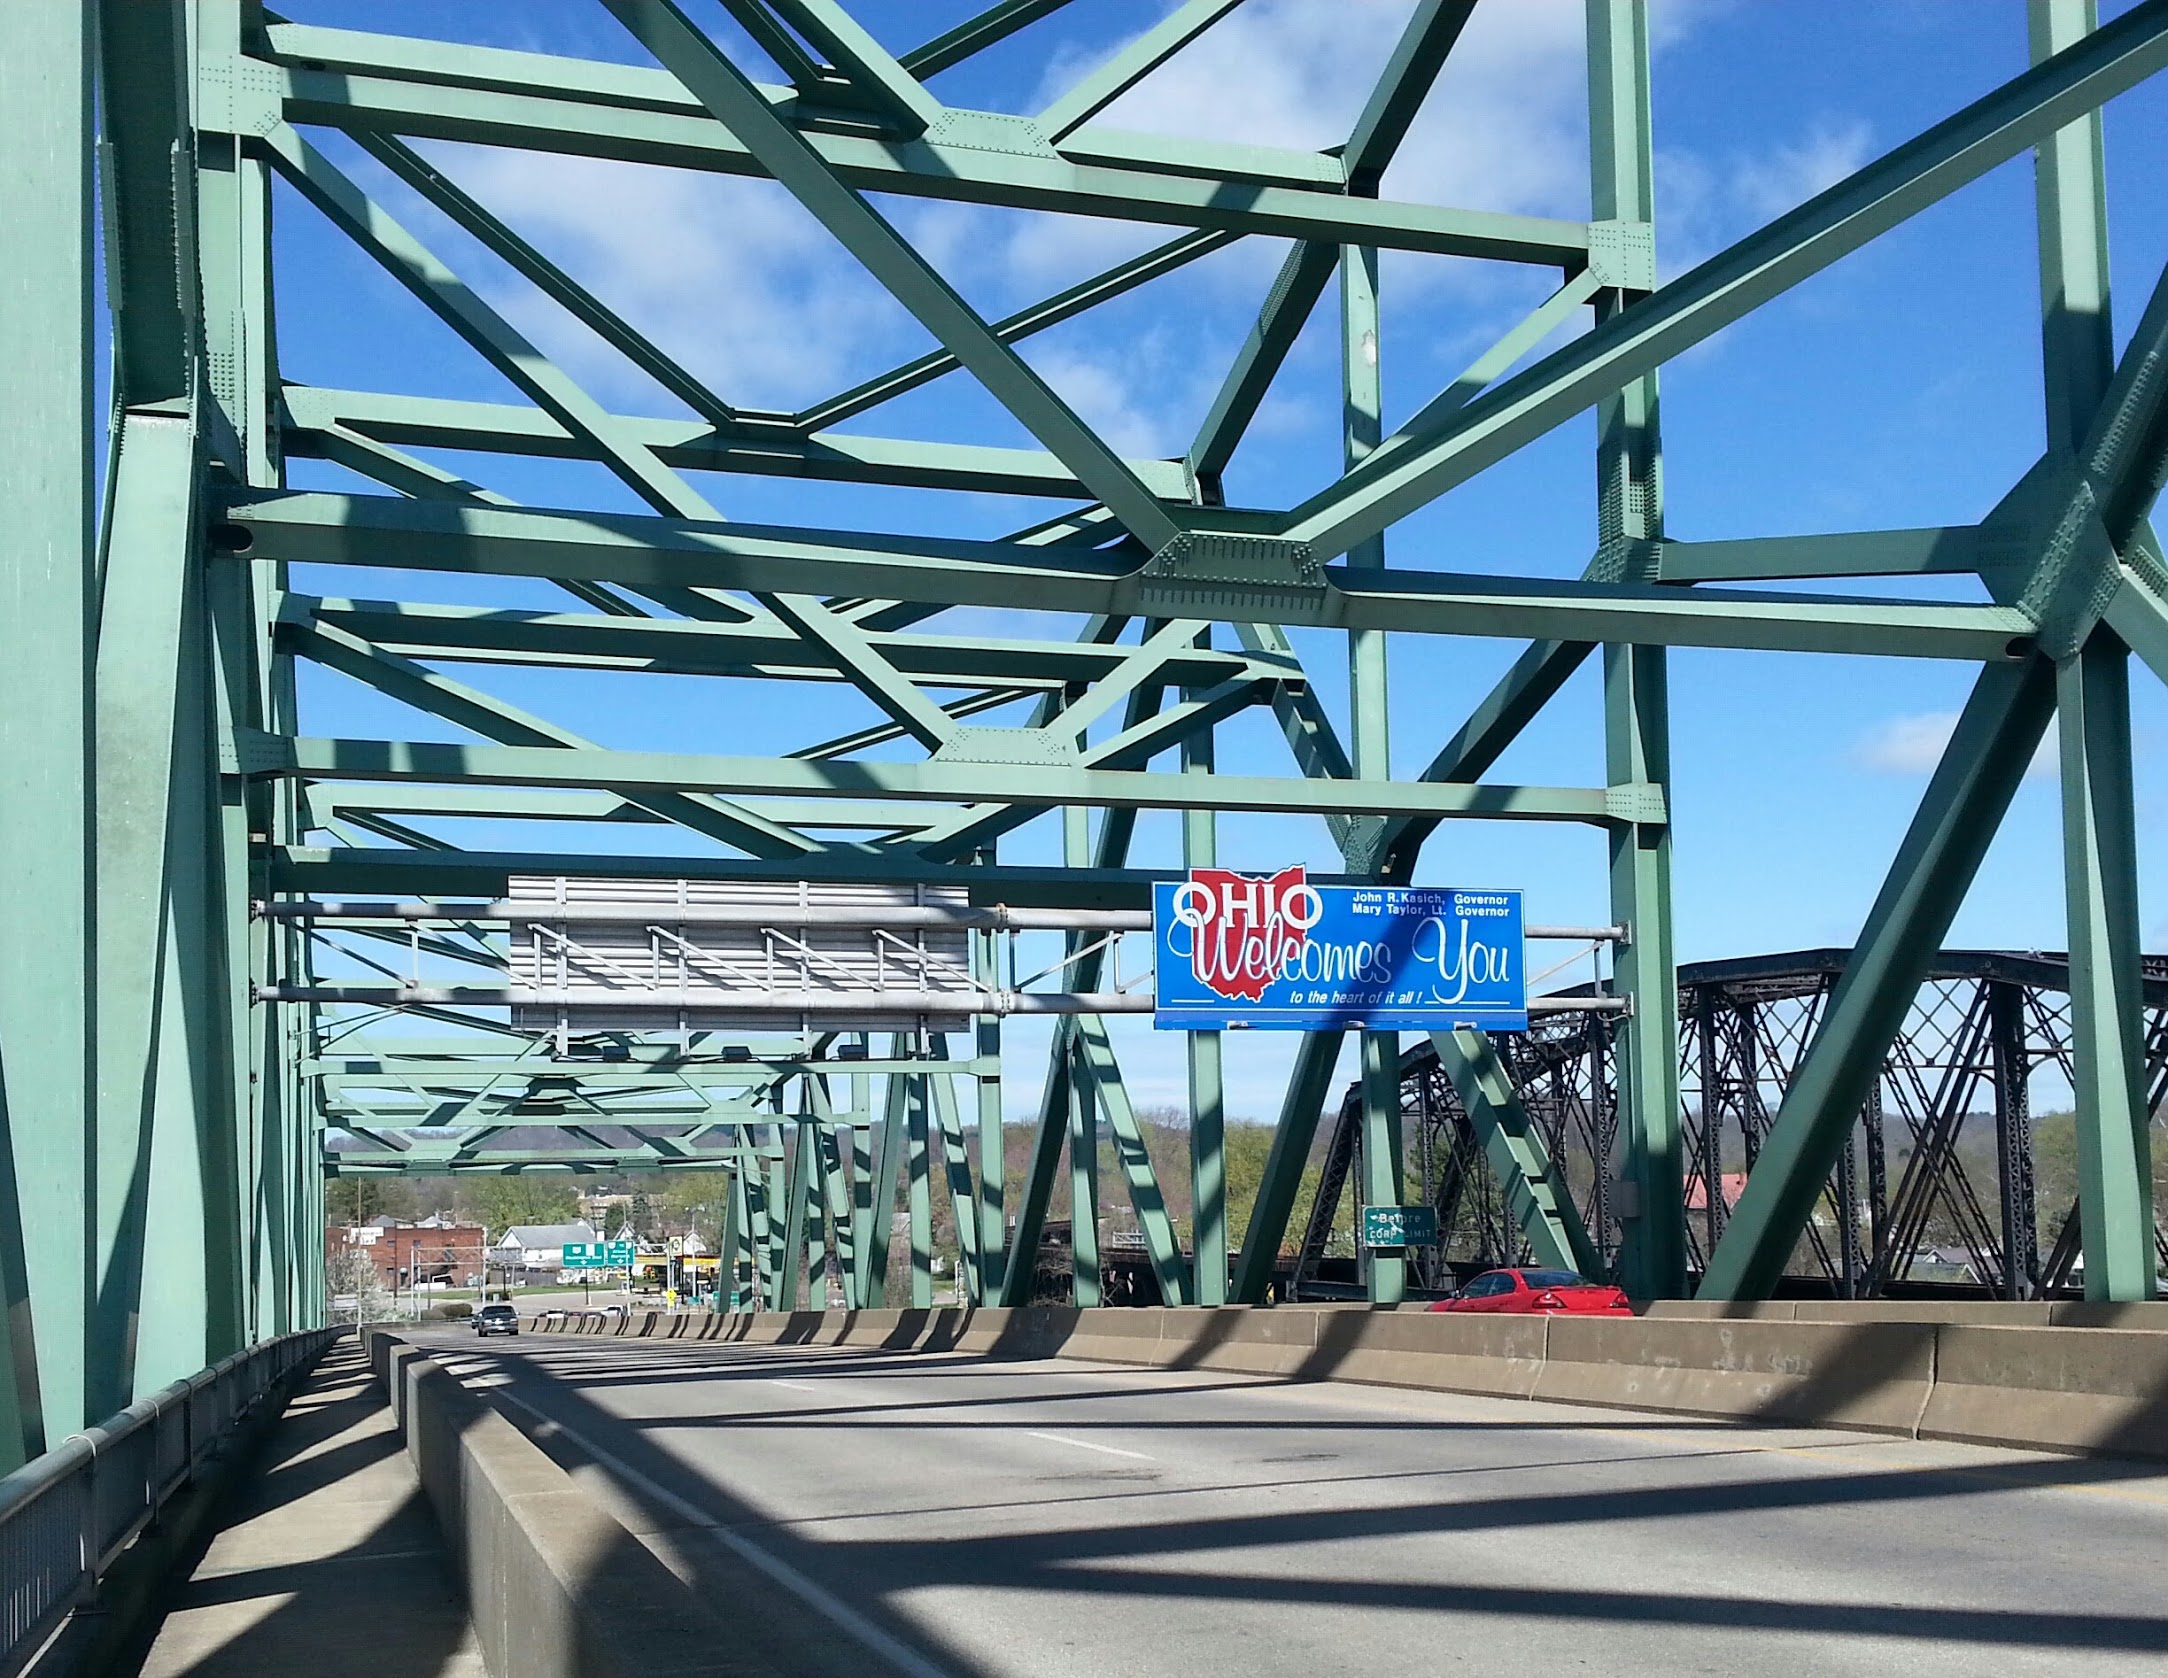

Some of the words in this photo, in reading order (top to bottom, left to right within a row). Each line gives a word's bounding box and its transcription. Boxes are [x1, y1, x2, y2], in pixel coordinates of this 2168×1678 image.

[1352, 890, 1382, 902] John
[1400, 892, 1446, 905] Kasich,
[1453, 893, 1509, 905] Governor
[1172, 881, 1324, 930] OHIO
[1352, 903, 1382, 916] Mary
[1386, 904, 1426, 916] Taylor,
[1431, 906, 1447, 915] Lt.
[1455, 905, 1510, 917] Governor
[1167, 911, 1392, 984] Welcomes
[1412, 916, 1510, 1005] You
[1289, 990, 1304, 1004] to
[1307, 990, 1328, 1004] the
[1331, 990, 1365, 1004] heart
[1368, 991, 1383, 1004] of
[1384, 991, 1395, 1004] it
[1369, 1229, 1397, 1240] CORP
[1404, 1229, 1432, 1238] LIMIT
